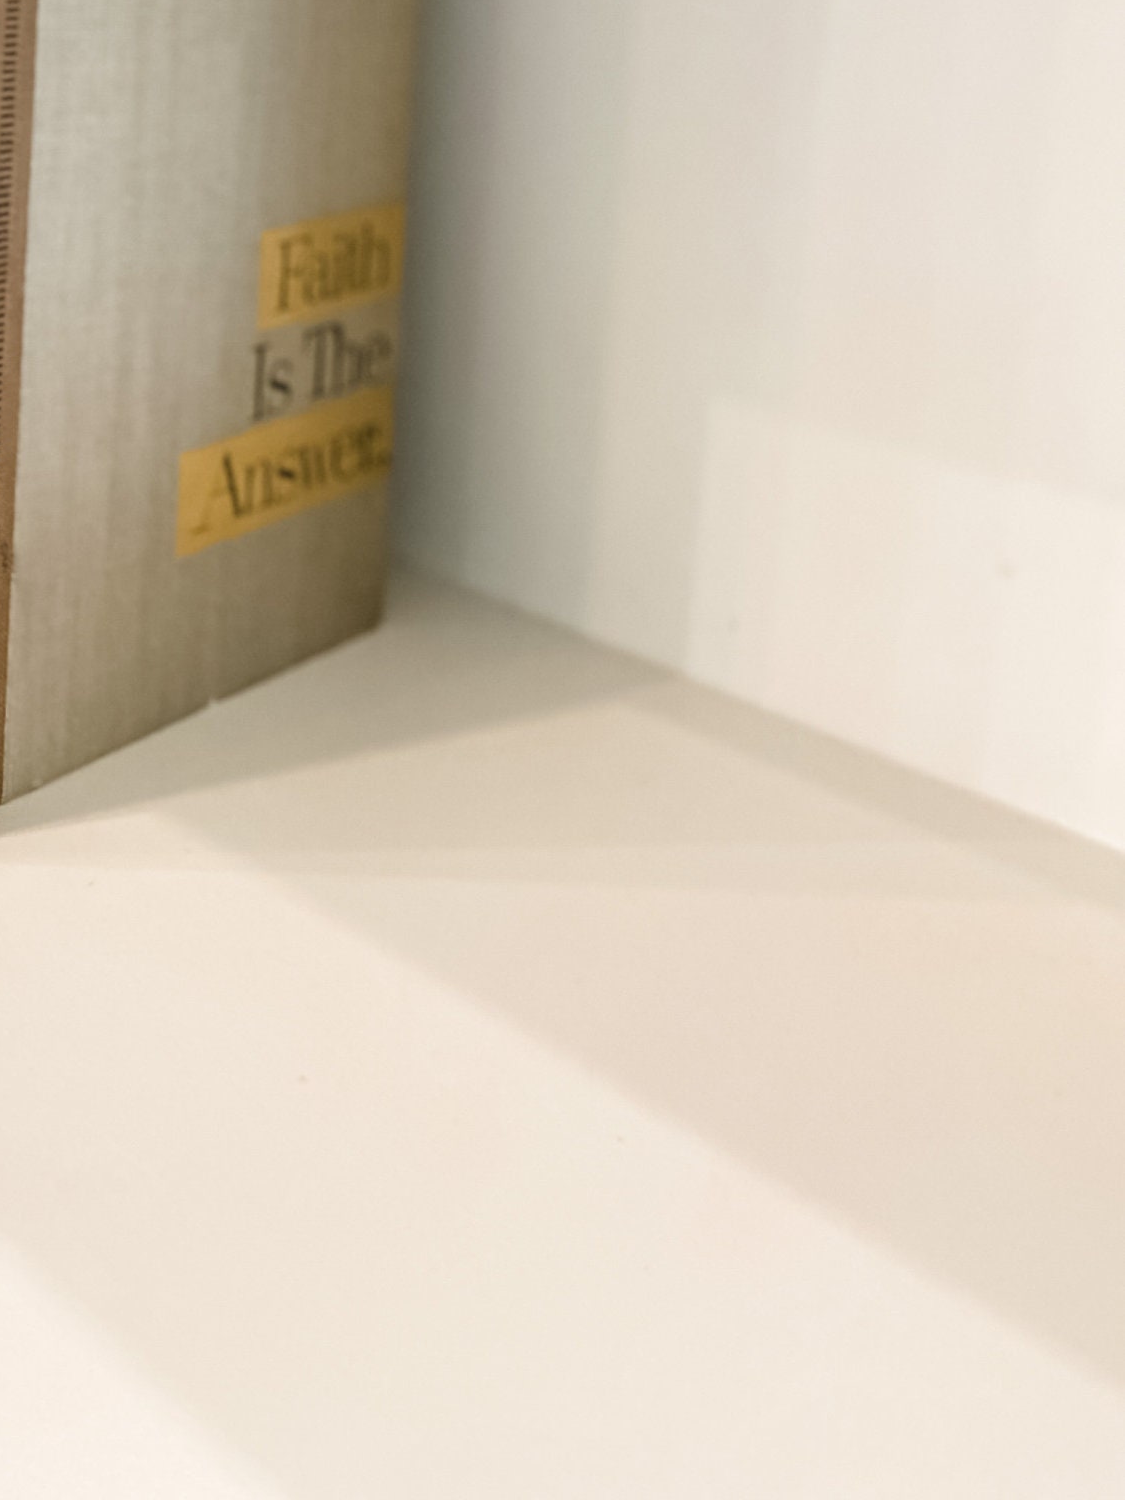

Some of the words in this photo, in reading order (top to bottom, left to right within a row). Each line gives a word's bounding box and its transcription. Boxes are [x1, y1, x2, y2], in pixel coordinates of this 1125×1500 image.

[277, 220, 391, 312] Faith
[252, 341, 293, 422] Is
[302, 321, 395, 400] The
